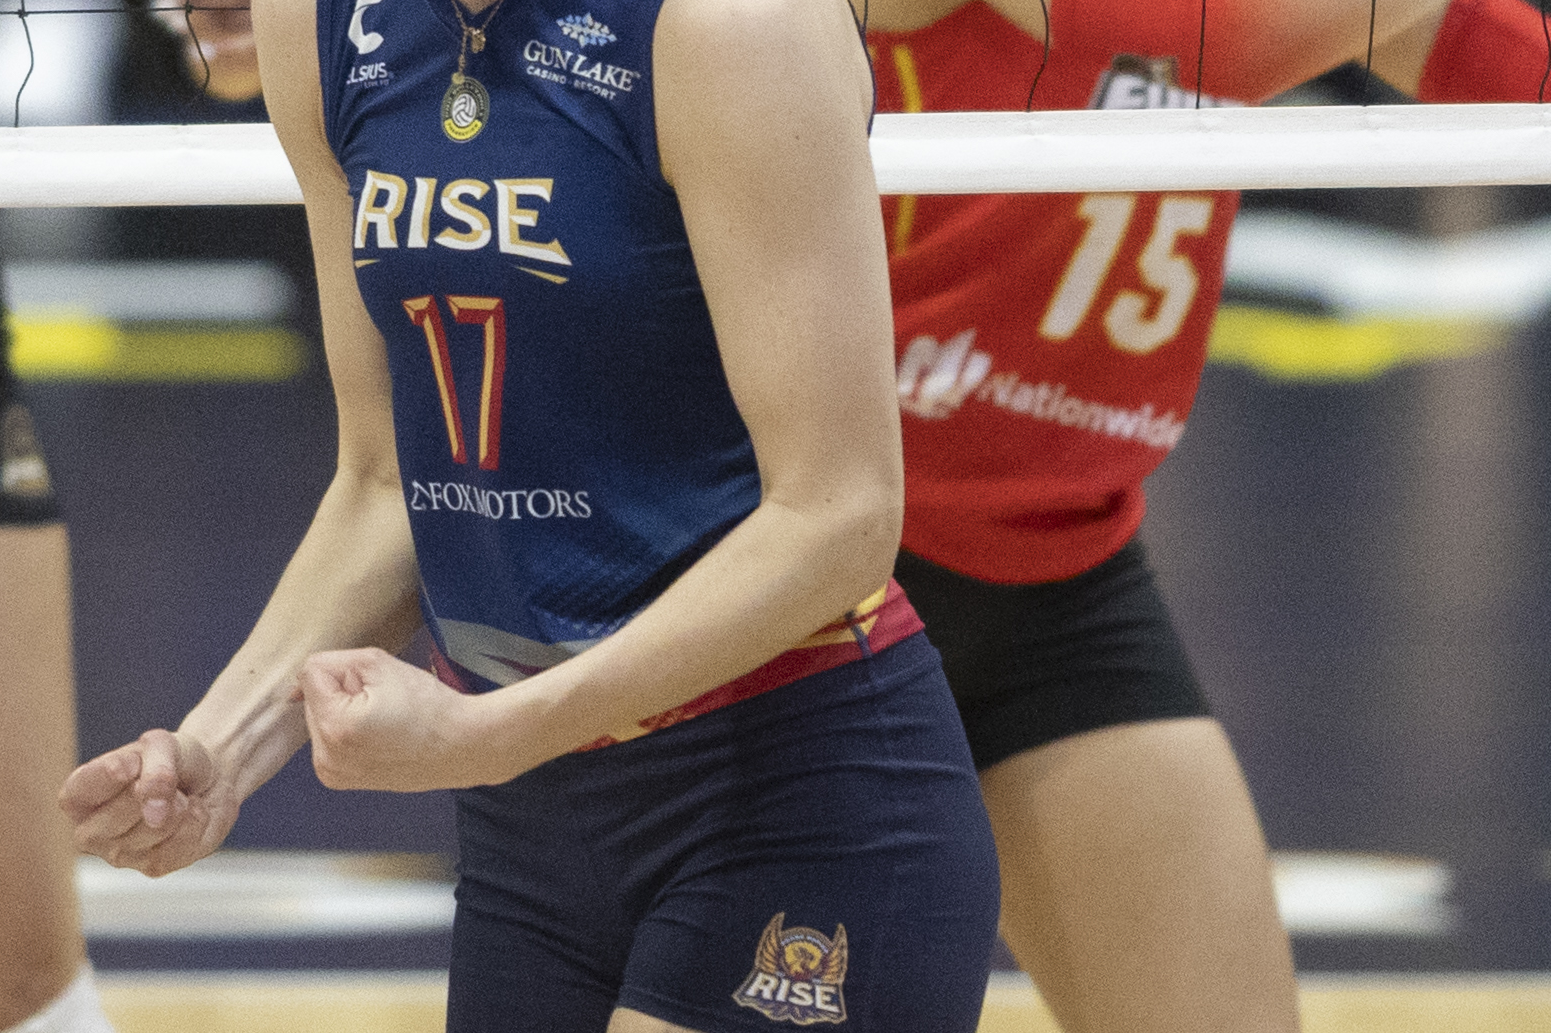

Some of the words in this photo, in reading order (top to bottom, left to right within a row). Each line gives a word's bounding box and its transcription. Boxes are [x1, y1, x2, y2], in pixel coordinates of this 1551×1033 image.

[523, 39, 573, 71] GUN
[571, 54, 634, 93] LAKE
[526, 65, 567, 85] CASINO
[573, 79, 618, 101] RESORT
[354, 169, 572, 266] RISE
[1038, 192, 1214, 355] 15
[402, 294, 506, 470] 17
[429, 482, 474, 513] FOX
[746, 971, 842, 1014] RISE
